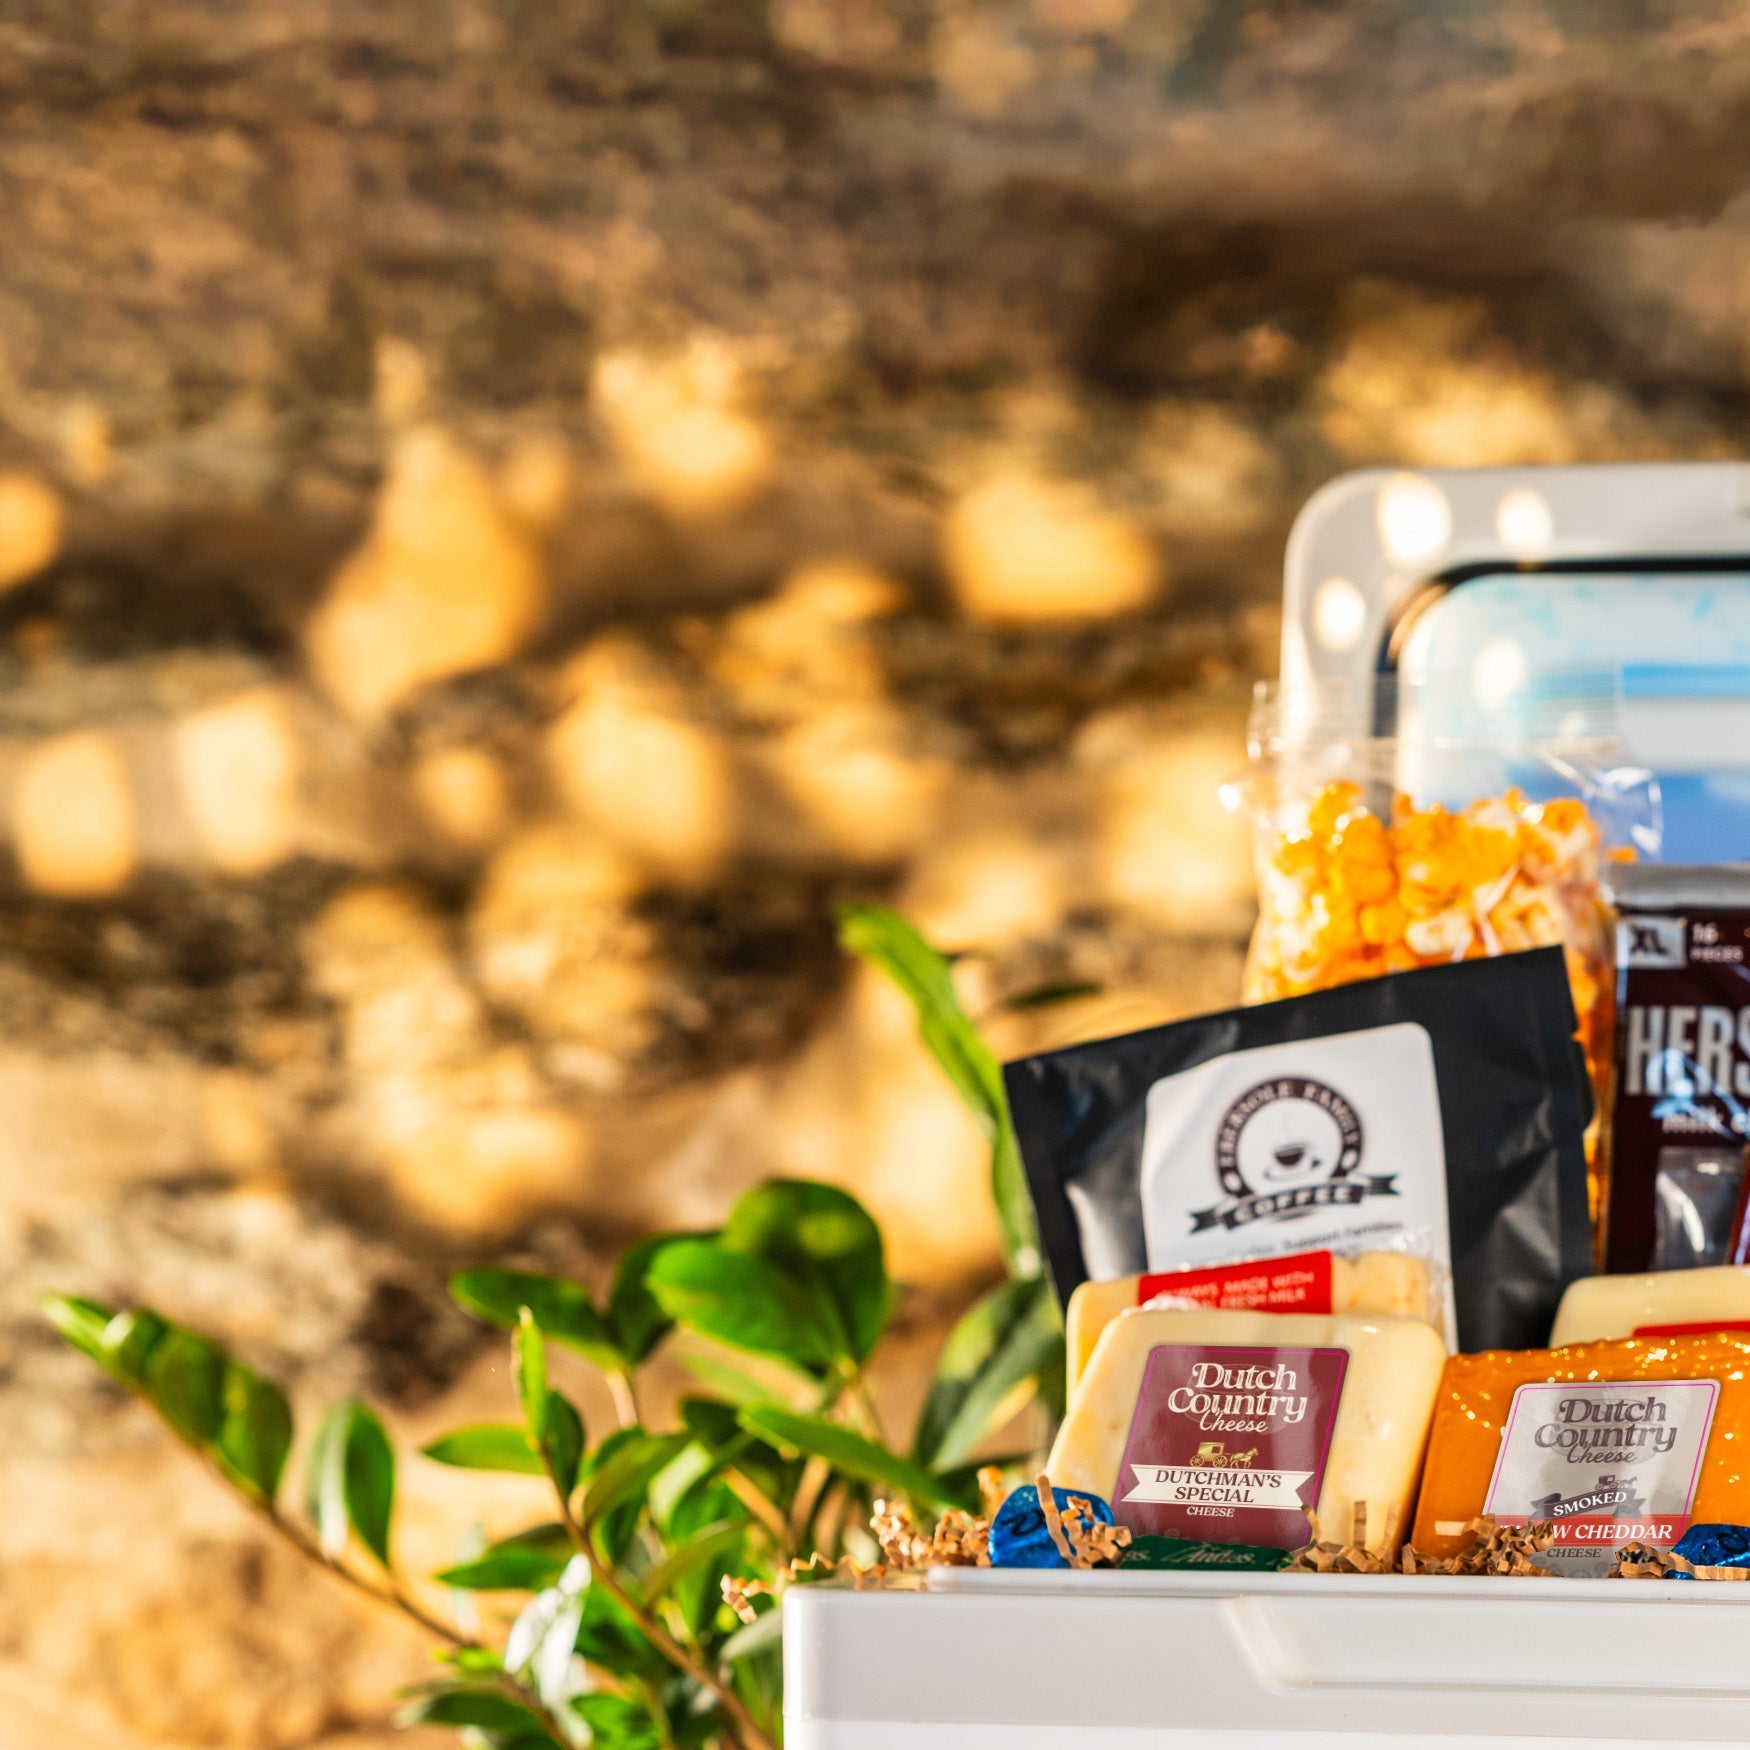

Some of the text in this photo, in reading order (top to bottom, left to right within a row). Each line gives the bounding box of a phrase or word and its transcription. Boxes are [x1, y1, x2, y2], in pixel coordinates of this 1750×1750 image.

[1629, 924, 1668, 956] XL
[1692, 921, 1719, 944] 16
[1662, 1106, 1723, 1133] milk
[1233, 1185, 1353, 1223] COFFEE
[1223, 1275, 1268, 1294] MADE
[1271, 1271, 1315, 1287] WITH
[1268, 1287, 1307, 1303] MILK
[1192, 1361, 1297, 1391] Dutch
[1168, 1387, 1308, 1424] Country
[1558, 1396, 1667, 1423] Dutch
[1198, 1407, 1269, 1433] Cheese
[1534, 1421, 1678, 1453] Country
[1566, 1441, 1636, 1464] Cheese
[1154, 1468, 1282, 1489] DUTCHMAN'S
[1173, 1485, 1254, 1503] SPECIAL
[1552, 1490, 1628, 1517] SMOKED
[1186, 1506, 1235, 1518] CHEESE
[1574, 1523, 1674, 1540] CHEDDAR
[1546, 1548, 1602, 1558] CHEESE
